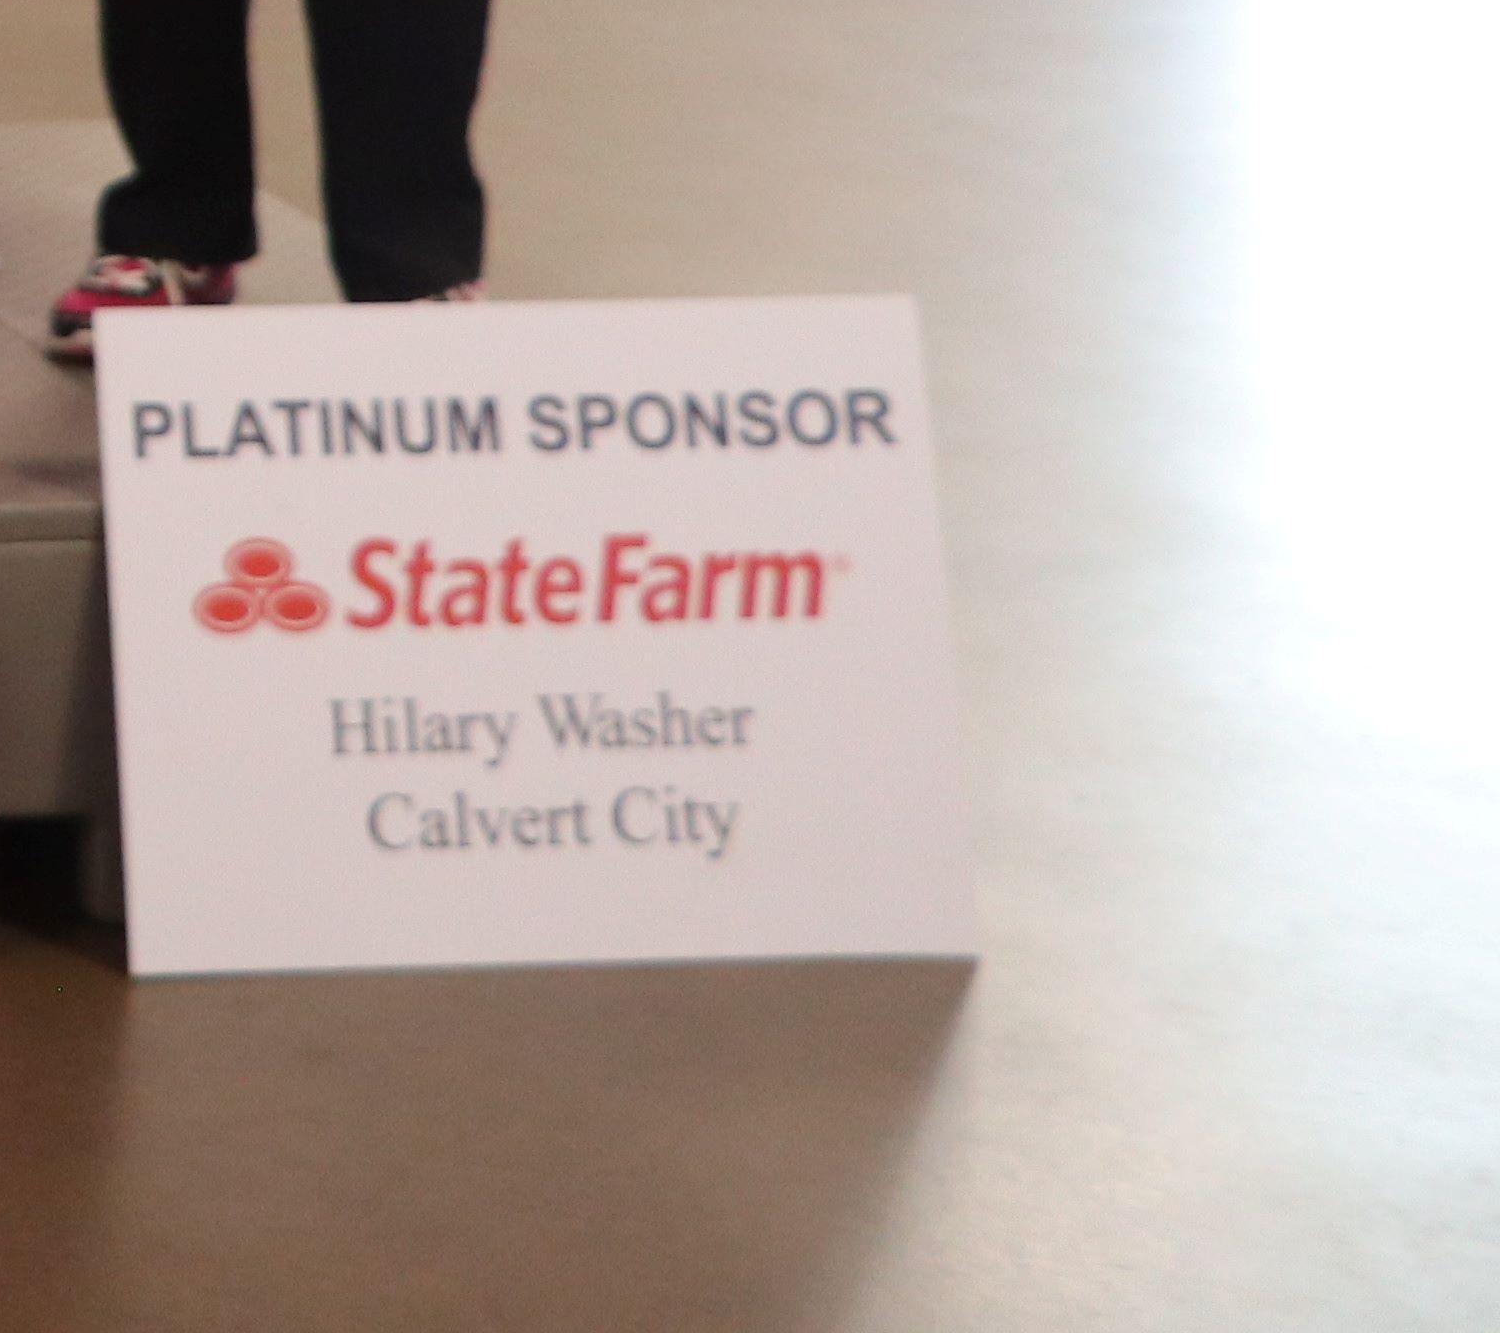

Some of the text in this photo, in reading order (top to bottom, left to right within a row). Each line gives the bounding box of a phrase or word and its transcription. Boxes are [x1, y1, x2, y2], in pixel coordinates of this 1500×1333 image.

[132, 388, 899, 460] PLATINUM SPONSOR
[329, 690, 756, 768] Hilary Washer
[368, 784, 741, 860] Calvert City
